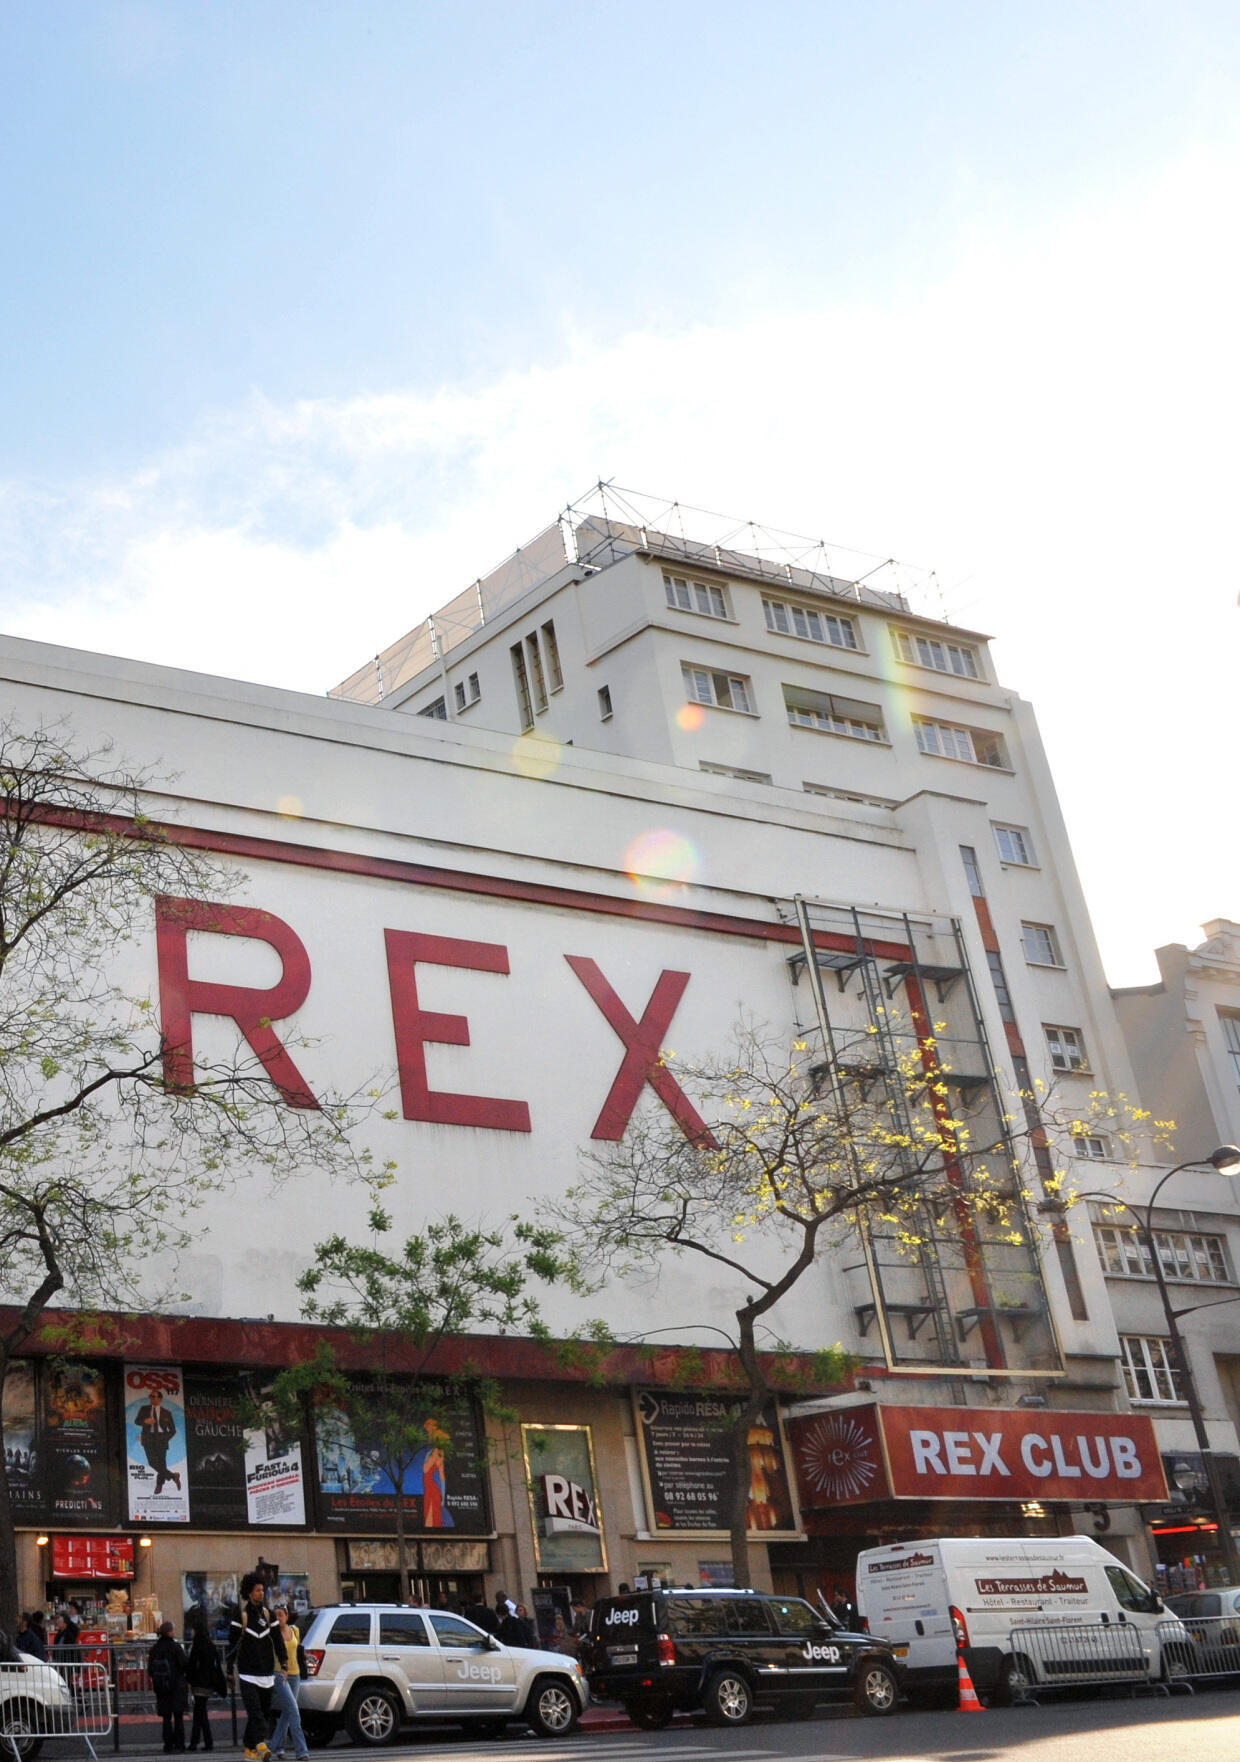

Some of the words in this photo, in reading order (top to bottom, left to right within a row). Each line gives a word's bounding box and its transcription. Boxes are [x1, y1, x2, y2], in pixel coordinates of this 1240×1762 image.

[155, 893, 719, 1150] REX
[127, 1370, 180, 1390] OSS
[660, 1401, 694, 1419] Rapido
[194, 1423, 242, 1437] GAUCHE
[909, 1429, 1010, 1476] REX
[1020, 1432, 1143, 1479] CLUB
[246, 1464, 290, 1484] FURIOUS
[290, 1461, 299, 1472] 4
[255, 1461, 281, 1474] FAST
[544, 1474, 597, 1528] REX
[664, 1491, 674, 1501] 08
[675, 1491, 685, 1501] 92
[686, 1491, 696, 1501] 68
[697, 1491, 706, 1501] 05
[978, 1580, 994, 1593] Les
[995, 1579, 1035, 1592] Terrasses
[1037, 1579, 1048, 1592] de
[1049, 1579, 1084, 1592] Saumur
[982, 1597, 1004, 1606] Hôtel
[1011, 1598, 1053, 1606] Restaurant
[1059, 1597, 1089, 1606] Traiteur
[605, 1607, 639, 1626] Jeep
[802, 1642, 840, 1663] Jeep
[457, 1660, 502, 1684] Jeep
